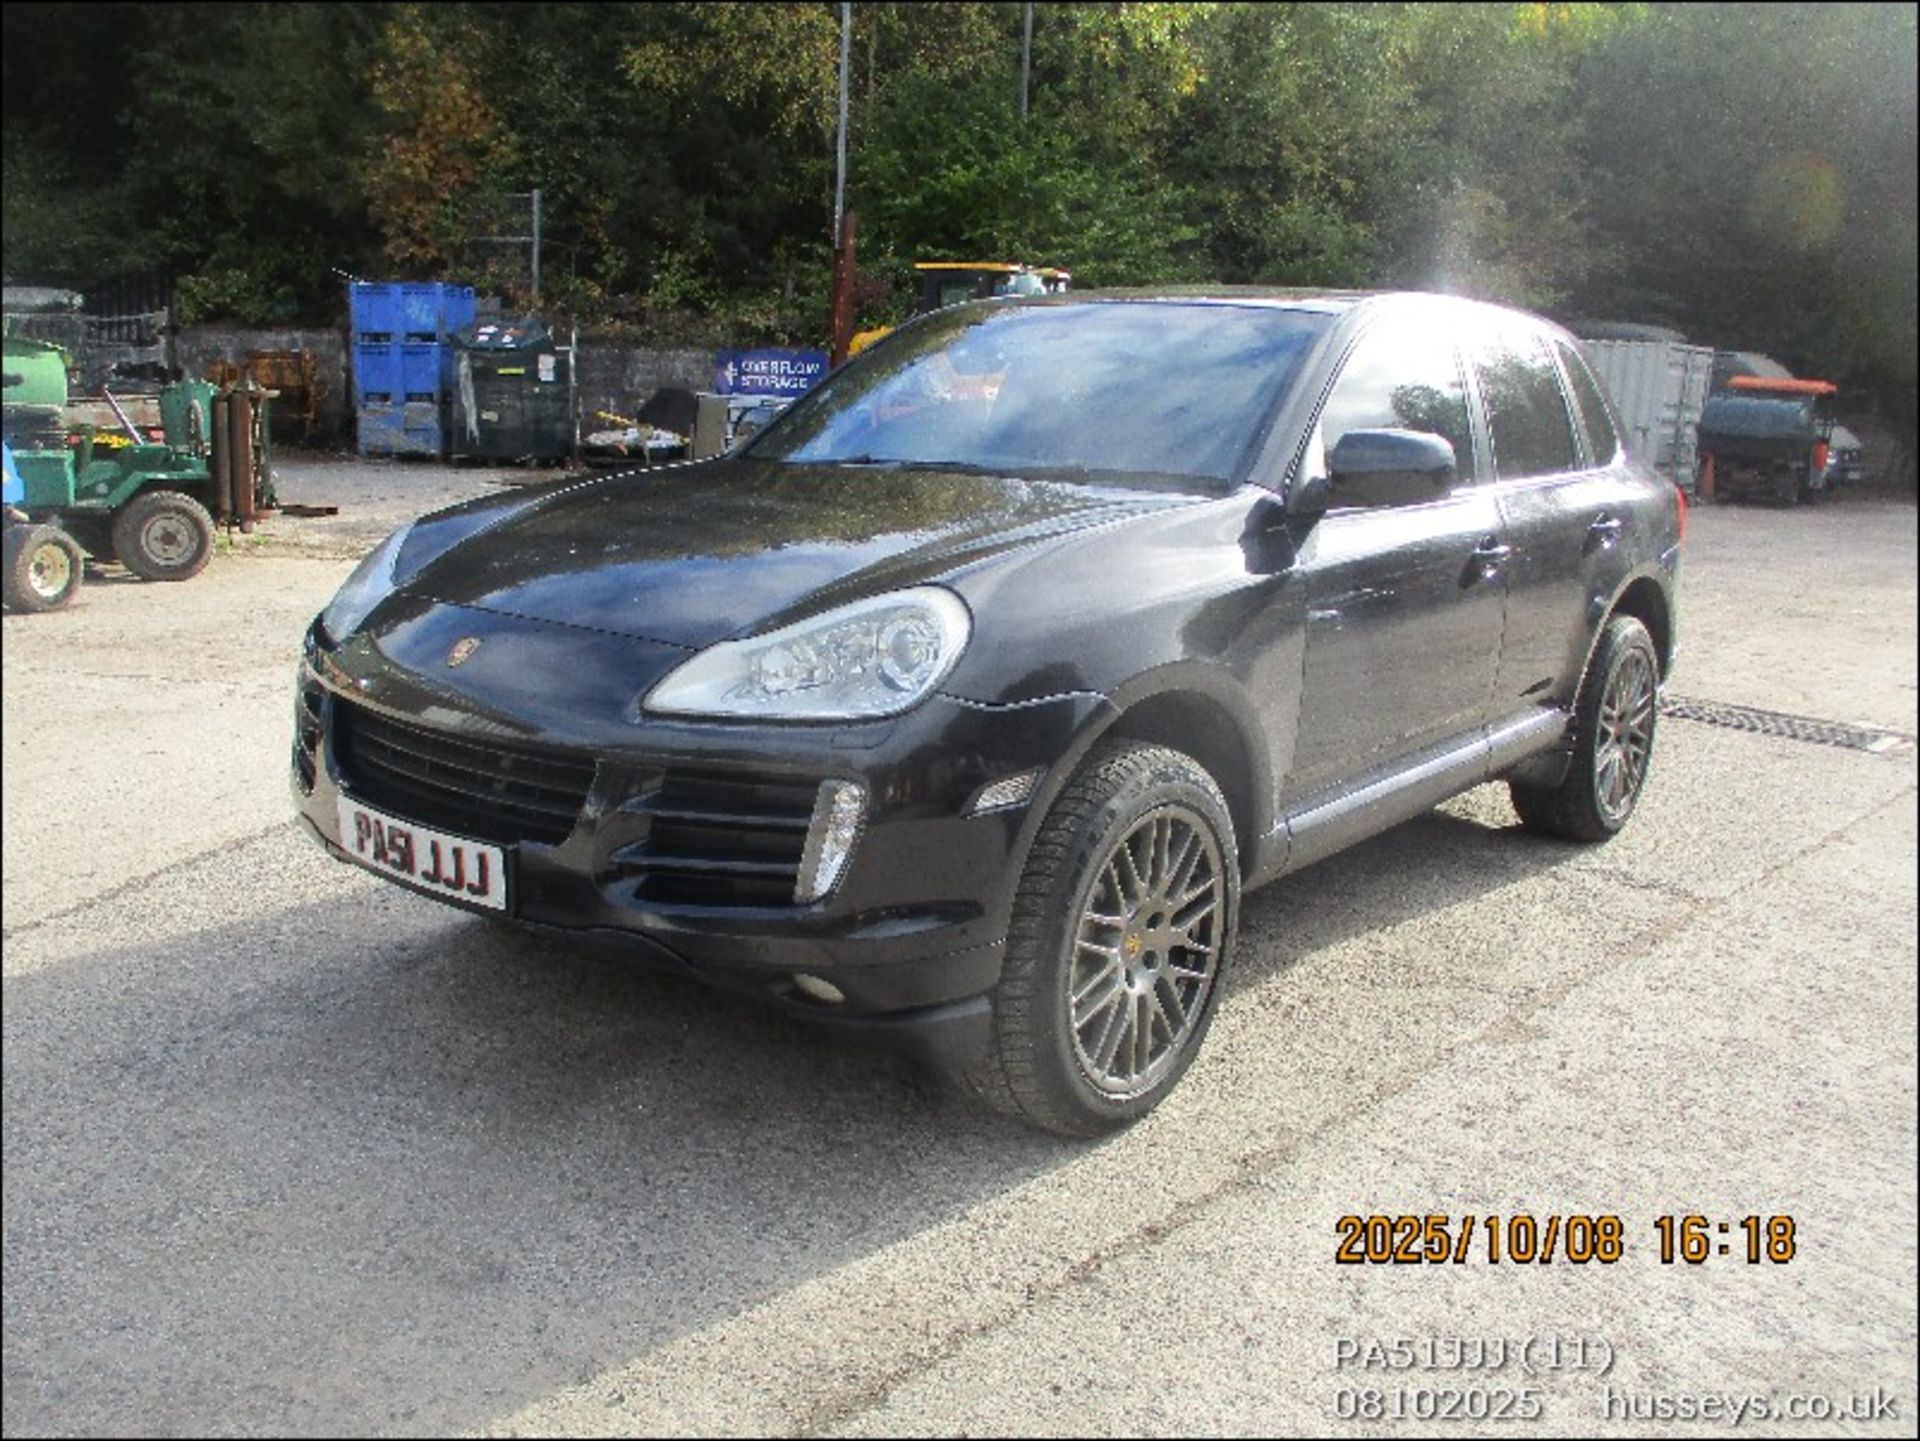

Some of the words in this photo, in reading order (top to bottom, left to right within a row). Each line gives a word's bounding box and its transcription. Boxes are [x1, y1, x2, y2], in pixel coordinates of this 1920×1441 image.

[741, 361, 819, 374] OVERFLOW
[741, 375, 807, 388] STORAGE
[421, 840, 488, 895] JJJ
